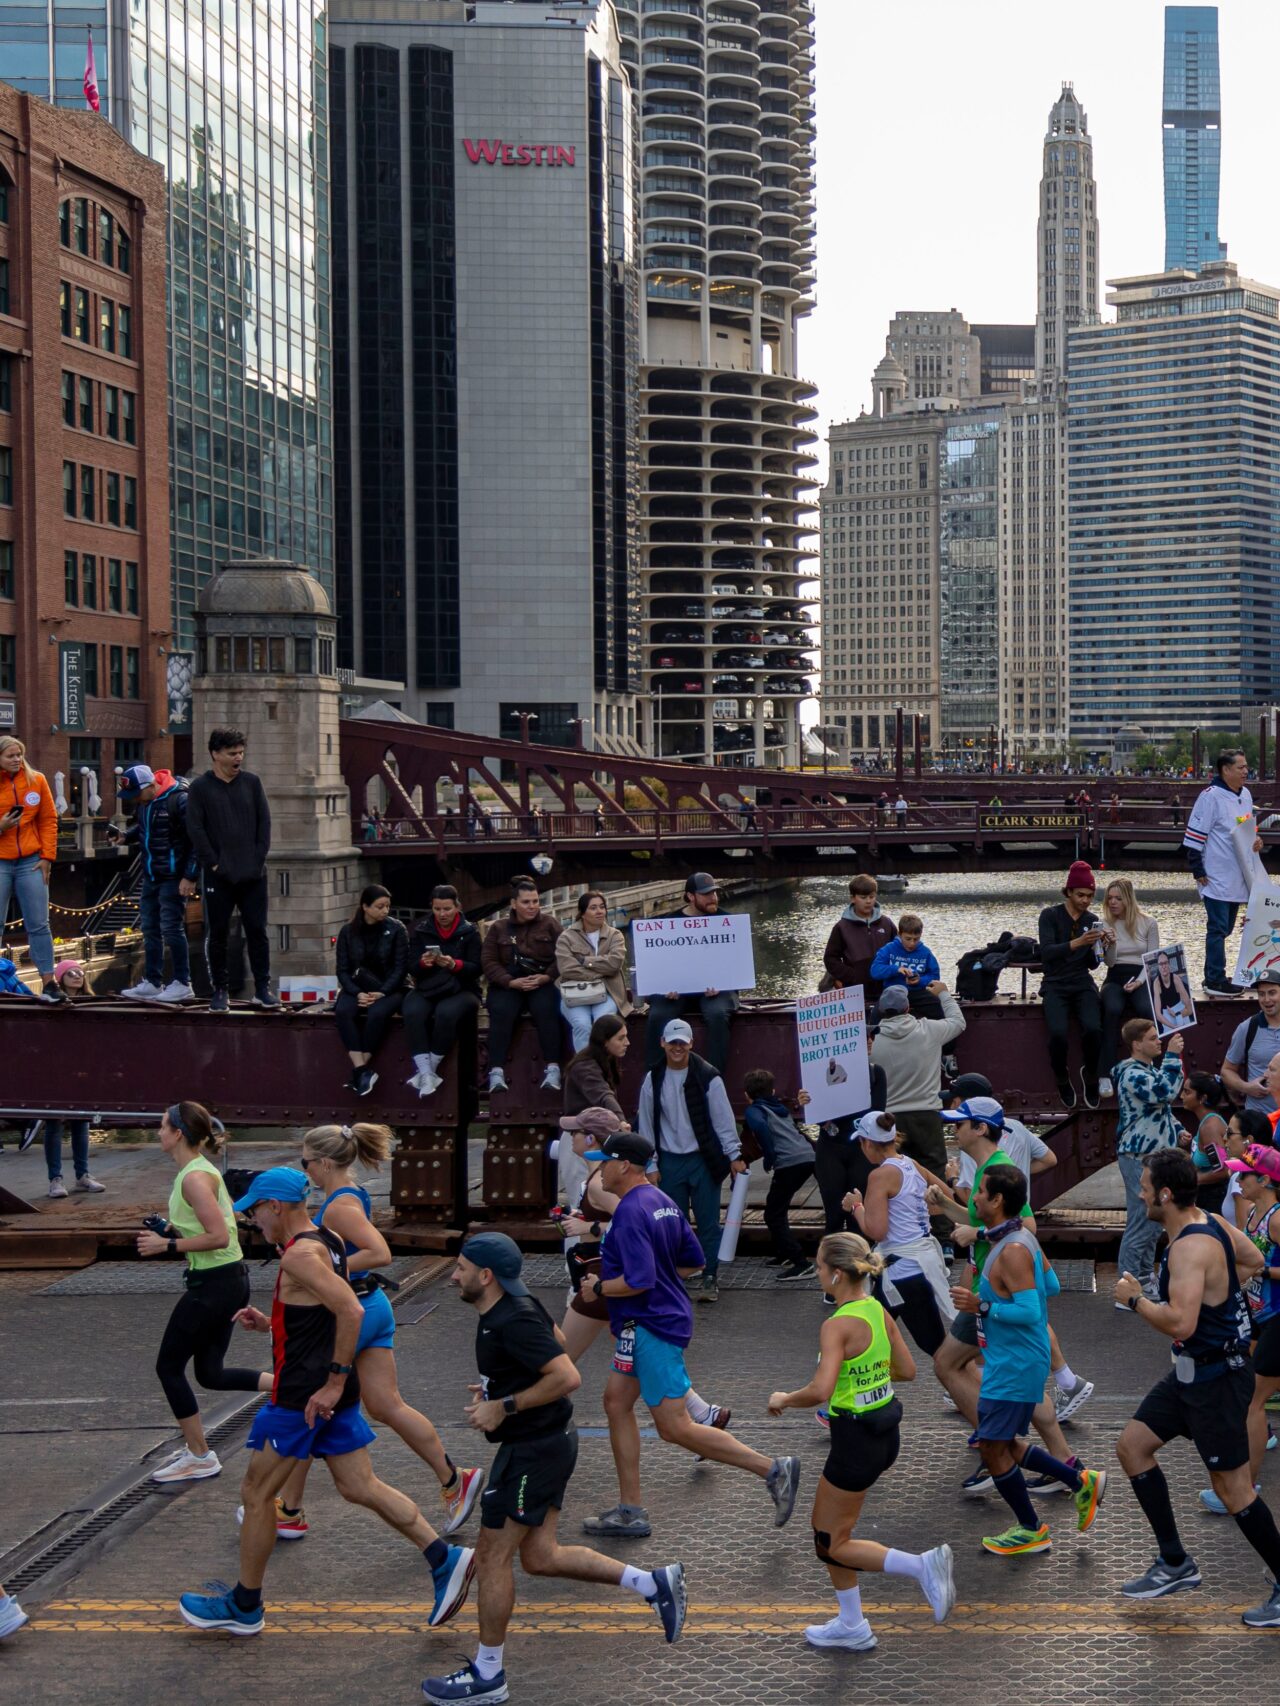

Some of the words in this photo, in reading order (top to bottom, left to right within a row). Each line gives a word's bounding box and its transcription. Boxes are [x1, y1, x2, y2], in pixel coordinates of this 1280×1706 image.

[1161, 285, 1187, 296] ROYAL
[1189, 279, 1226, 292] SONESTA
[985, 816, 1028, 826] CLARK
[1033, 816, 1080, 826] STREET
[636, 920, 664, 932] CAN
[670, 920, 675, 930] I
[683, 918, 710, 929] GET
[722, 917, 731, 927] A
[799, 1002, 846, 1022] BROTHA
[800, 1033, 828, 1048] WHY
[834, 1026, 860, 1041] THIS
[801, 1041, 857, 1063] BROTHA!?
[848, 1364, 871, 1376] ALL
[856, 1378, 872, 1387] for
[863, 1385, 888, 1405] LIBBY
